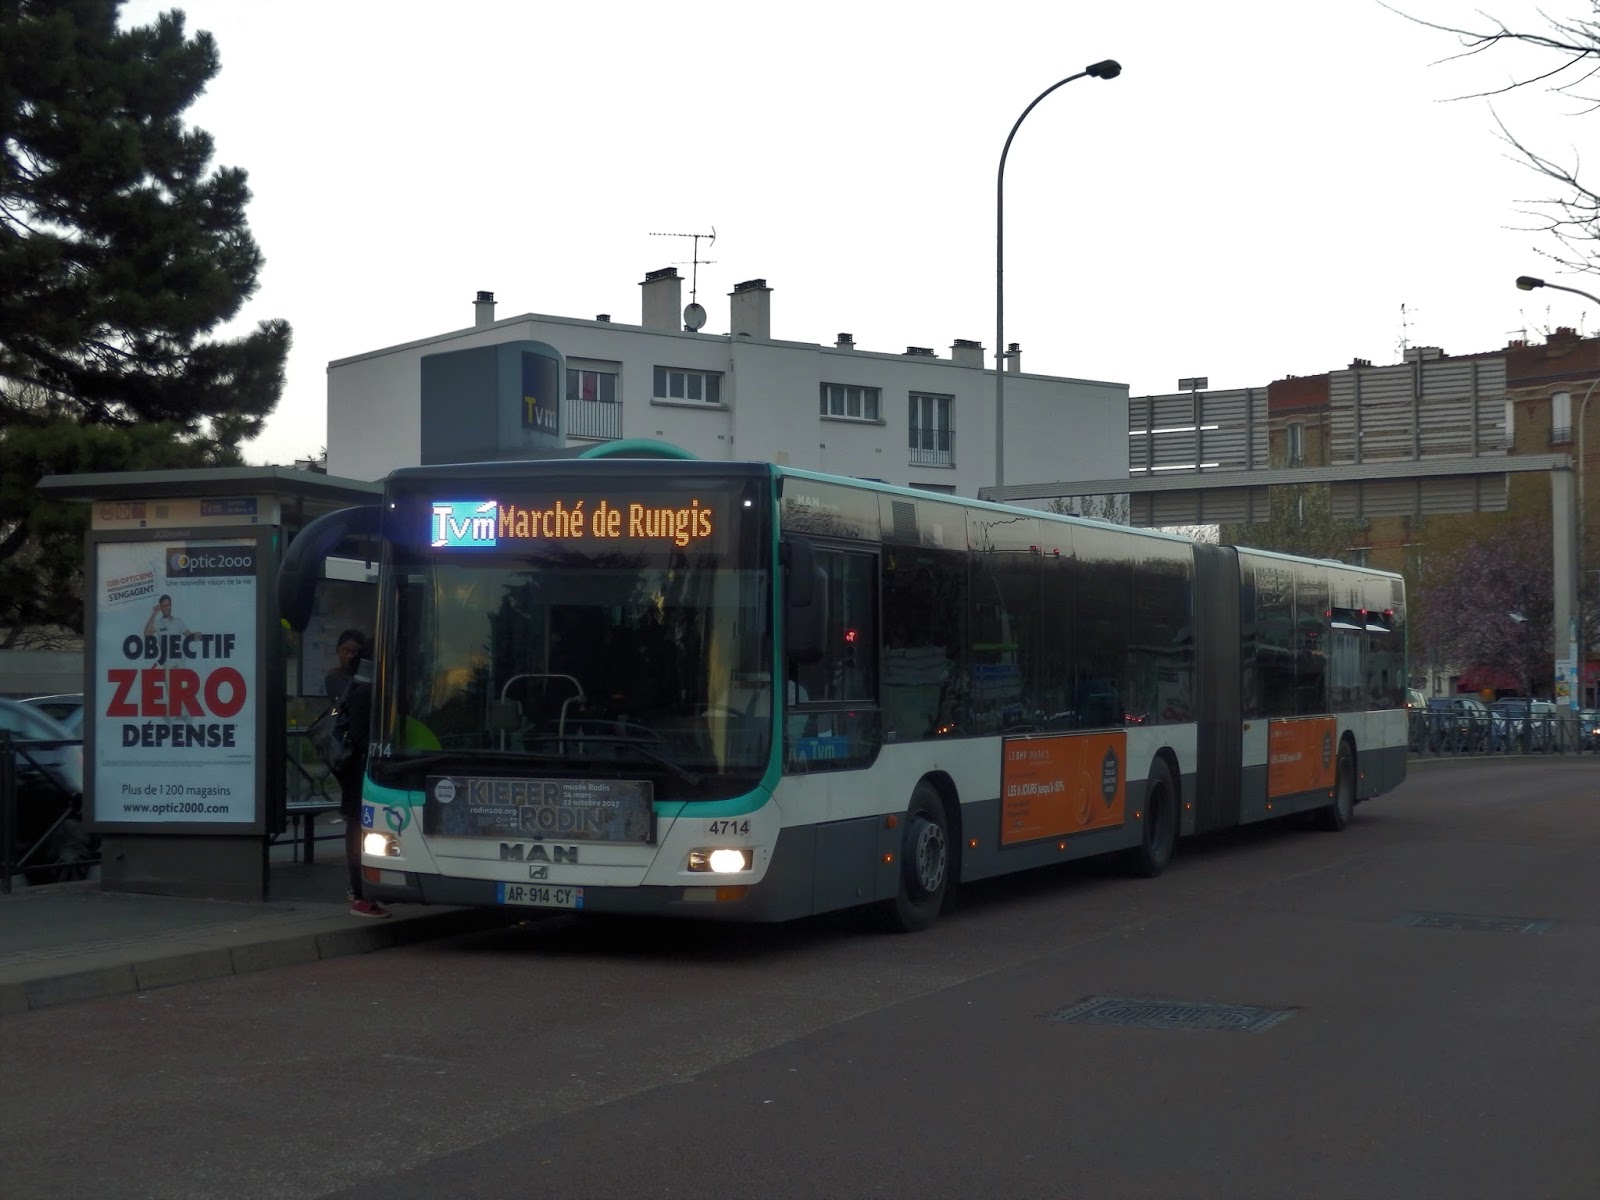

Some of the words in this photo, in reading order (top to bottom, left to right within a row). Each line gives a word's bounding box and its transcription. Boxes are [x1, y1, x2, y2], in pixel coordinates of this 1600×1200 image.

[525, 396, 556, 428] Tvm
[433, 504, 496, 543] Tvm
[499, 501, 584, 538] Marché
[592, 501, 621, 538] de
[629, 500, 712, 546] Rungis
[178, 554, 216, 572] Optic
[120, 571, 154, 584] OPTICIENS
[180, 578, 205, 586] nouvelle
[108, 584, 155, 602] S'ENGAGENT
[122, 634, 235, 665] OBJECTIF
[106, 663, 247, 718] ZÉRO
[810, 740, 835, 760] Tvm
[122, 784, 142, 795] Plus
[144, 784, 157, 795] de
[186, 785, 231, 798] magasins
[468, 780, 560, 806] KIEFER
[588, 783, 610, 791] Rodin
[123, 802, 229, 816] www.optic2000.com
[470, 807, 517, 816] rodin100.org
[602, 800, 620, 808] 2017
[519, 806, 604, 832] RODIN
[709, 820, 750, 835] 4714
[500, 843, 578, 863] MAN
